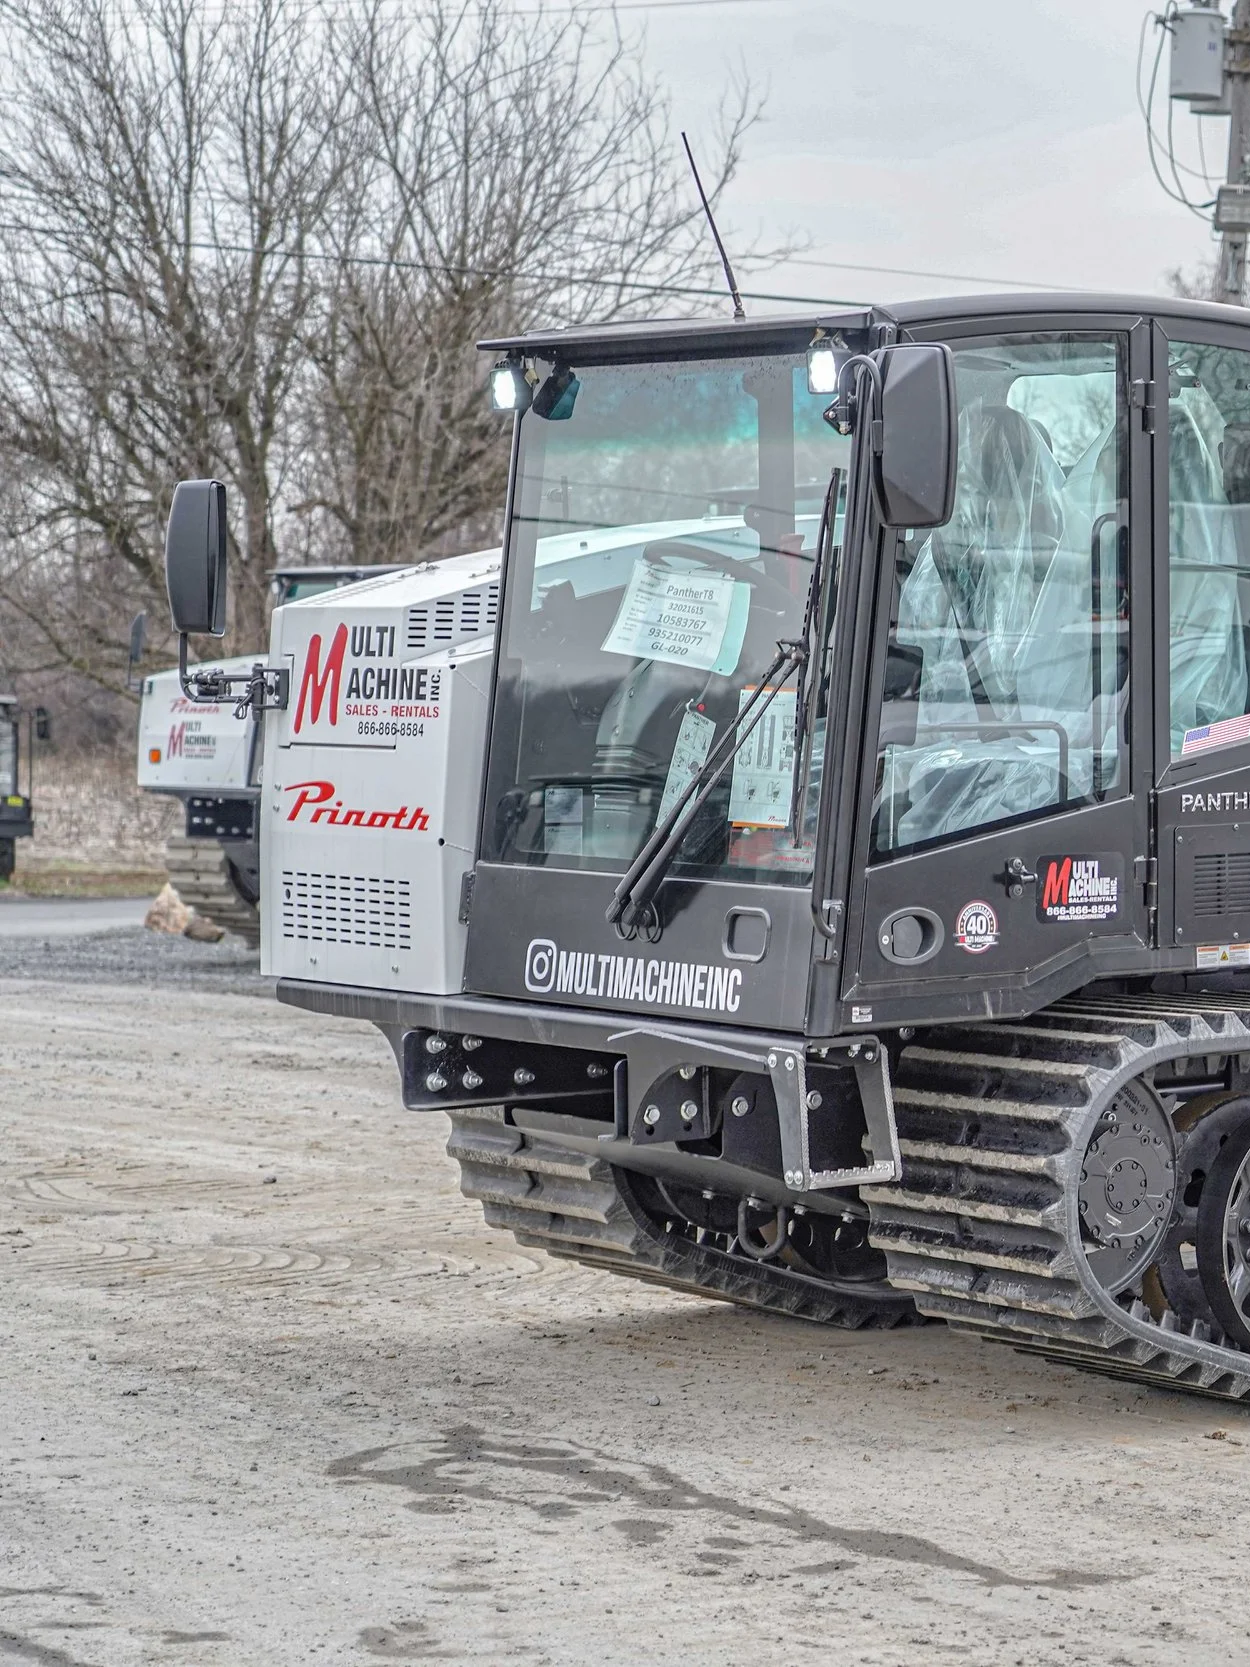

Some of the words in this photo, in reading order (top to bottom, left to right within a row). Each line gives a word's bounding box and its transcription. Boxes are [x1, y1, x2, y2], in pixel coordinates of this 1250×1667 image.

[666, 585, 714, 601] PantherT8
[668, 602, 704, 615] 32021615
[656, 613, 707, 631] 10583767
[648, 627, 703, 647] 935210077
[650, 641, 689, 656] GL-020
[430, 669, 442, 701] INC.
[345, 703, 378, 717] SALES
[390, 705, 440, 719] RENTALS
[357, 721, 424, 737] 866-866-8584
[284, 780, 430, 831] Prinoth
[1046, 904, 1117, 916] 866-866-8584
[967, 915, 987, 935] 40
[555, 950, 743, 1012] MULTIMACHINEINC
